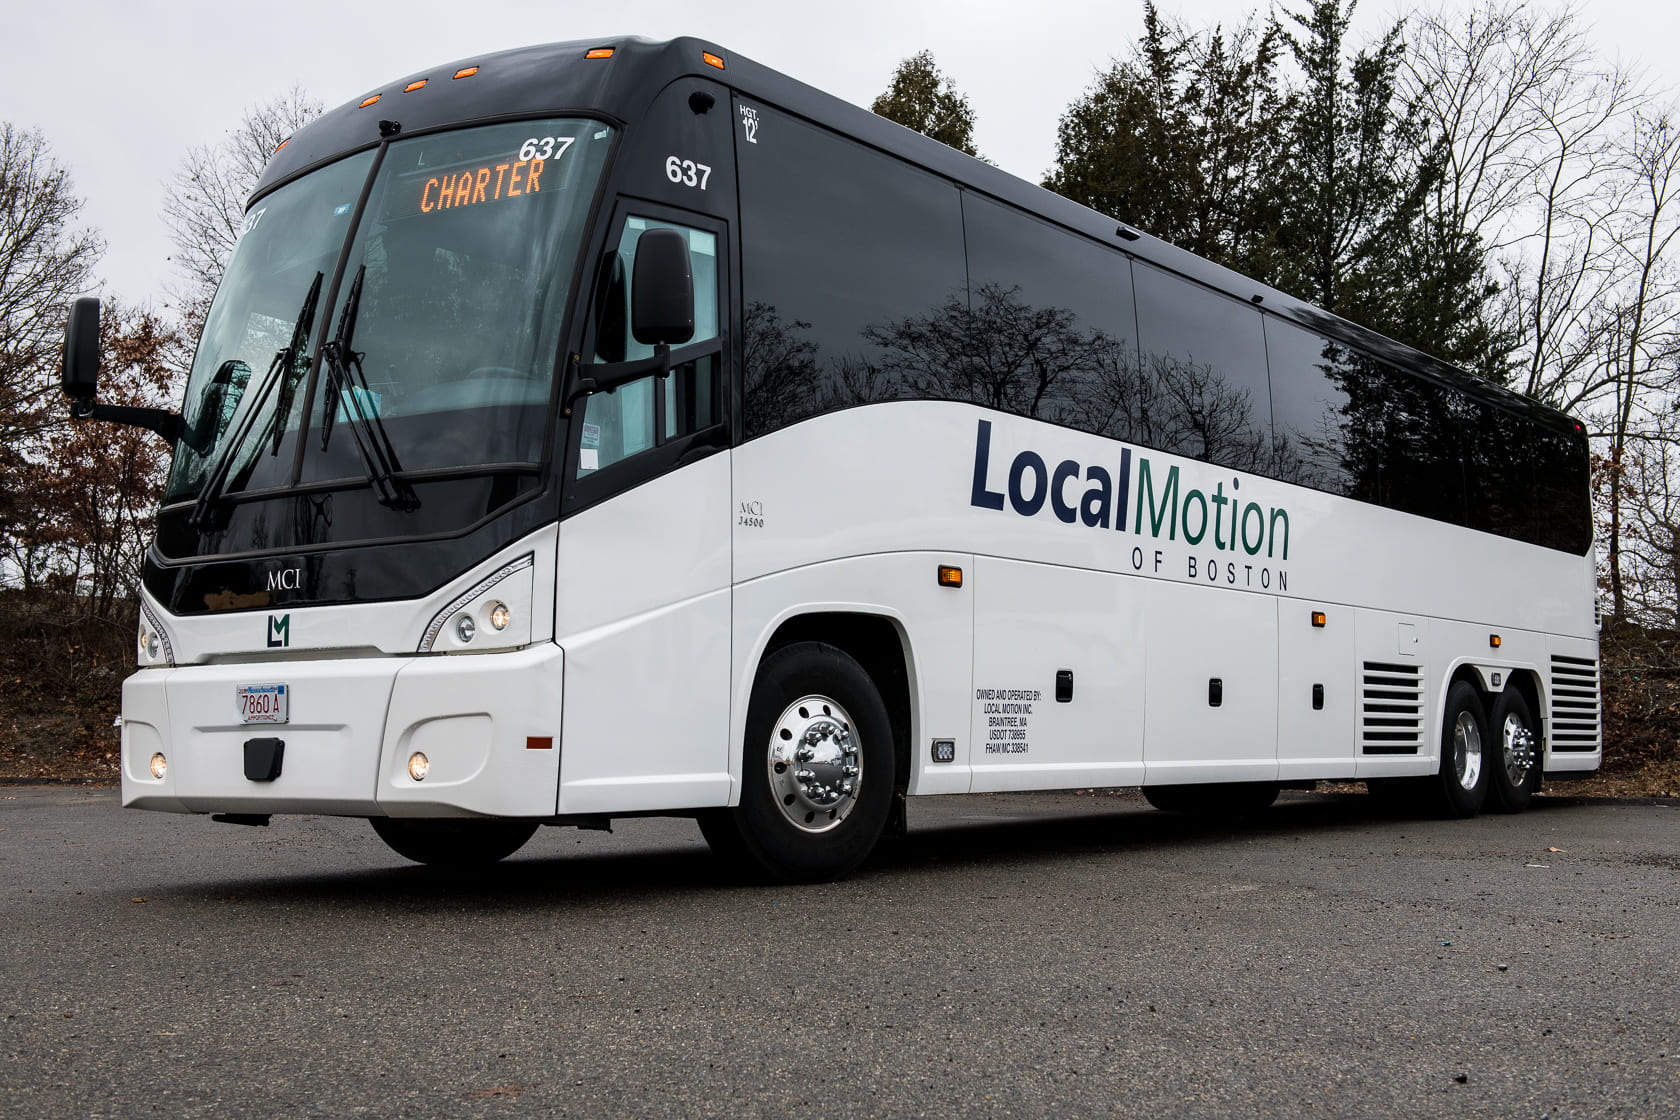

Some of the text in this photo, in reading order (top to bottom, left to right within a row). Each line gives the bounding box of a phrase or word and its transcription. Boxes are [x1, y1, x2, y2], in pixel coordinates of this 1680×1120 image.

[518, 136, 575, 161] 637
[665, 155, 712, 191] 637
[420, 159, 545, 213] CHARTER
[241, 207, 267, 235] 37
[970, 418, 1290, 561] LocalMotion
[265, 568, 301, 592] MCI
[1132, 546, 1288, 592] OF BOSTON
[241, 693, 280, 715] 7860 A
[977, 689, 1041, 701] OWNED AND OPERATED BY:
[984, 703, 1032, 715] LOCAL MOTION INC.
[988, 717, 1028, 728] BRAINTREE, MA
[989, 729, 1008, 741] USDOT
